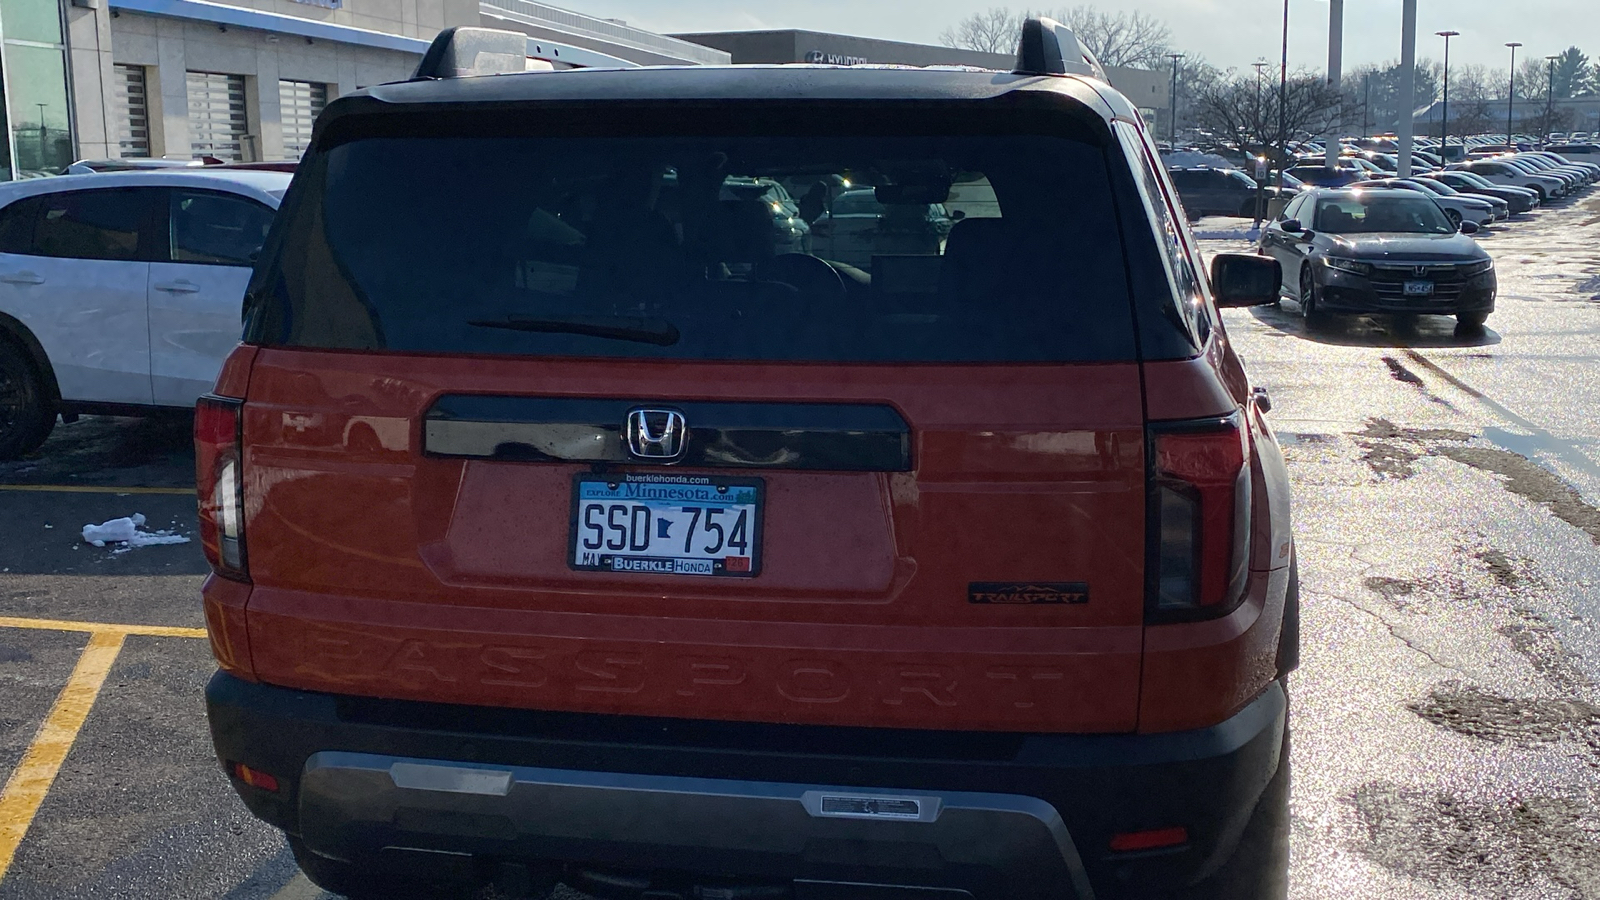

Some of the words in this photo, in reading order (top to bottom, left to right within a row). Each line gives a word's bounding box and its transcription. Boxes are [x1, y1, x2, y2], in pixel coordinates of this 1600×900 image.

[626, 474, 709, 484] buerklehonda.com
[583, 504, 651, 551] SSD
[682, 507, 748, 555] 754
[613, 557, 673, 571] BUERKLE
[674, 560, 711, 573] HONDA
[973, 593, 1084, 603] TRAILSPORT
[309, 634, 1064, 708] PASSPORT
